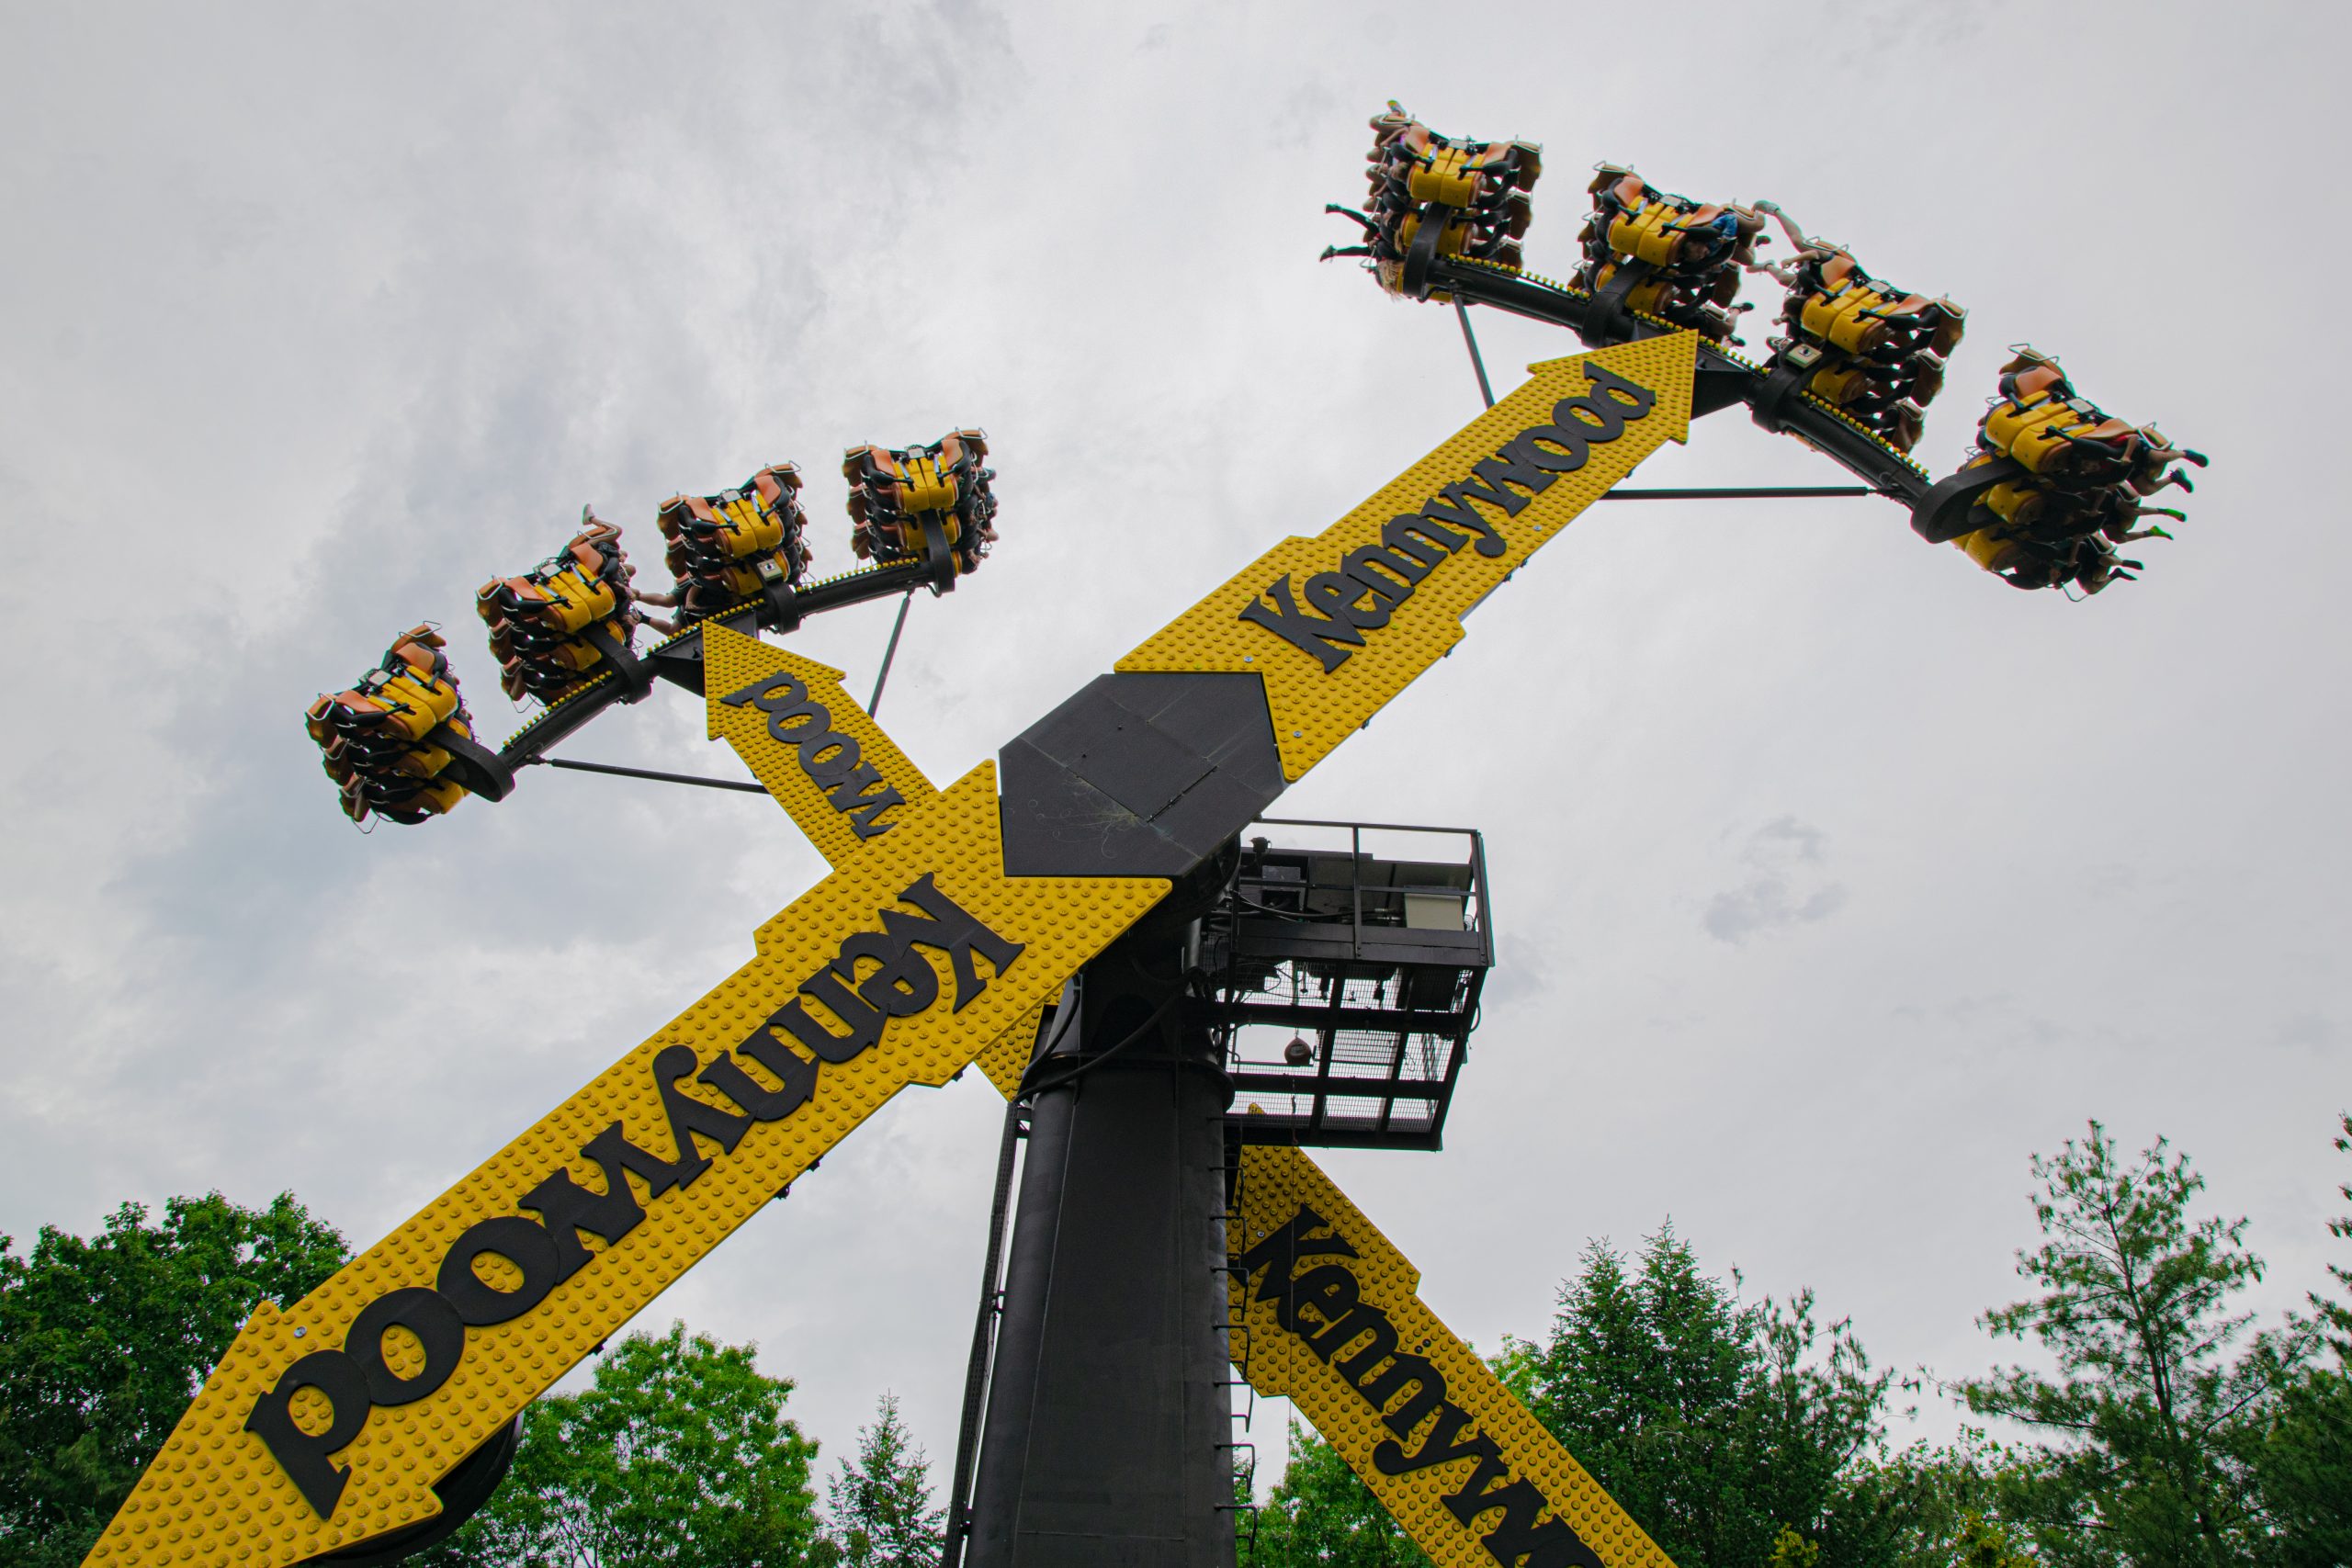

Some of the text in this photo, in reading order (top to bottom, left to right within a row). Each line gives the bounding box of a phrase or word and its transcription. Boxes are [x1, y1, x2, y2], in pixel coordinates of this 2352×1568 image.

[1238, 359, 1657, 675] Kennywood
[719, 670, 907, 842] wood
[243, 870, 1026, 1520] Kennywood
[1227, 1201, 1606, 1568] Kennyw
